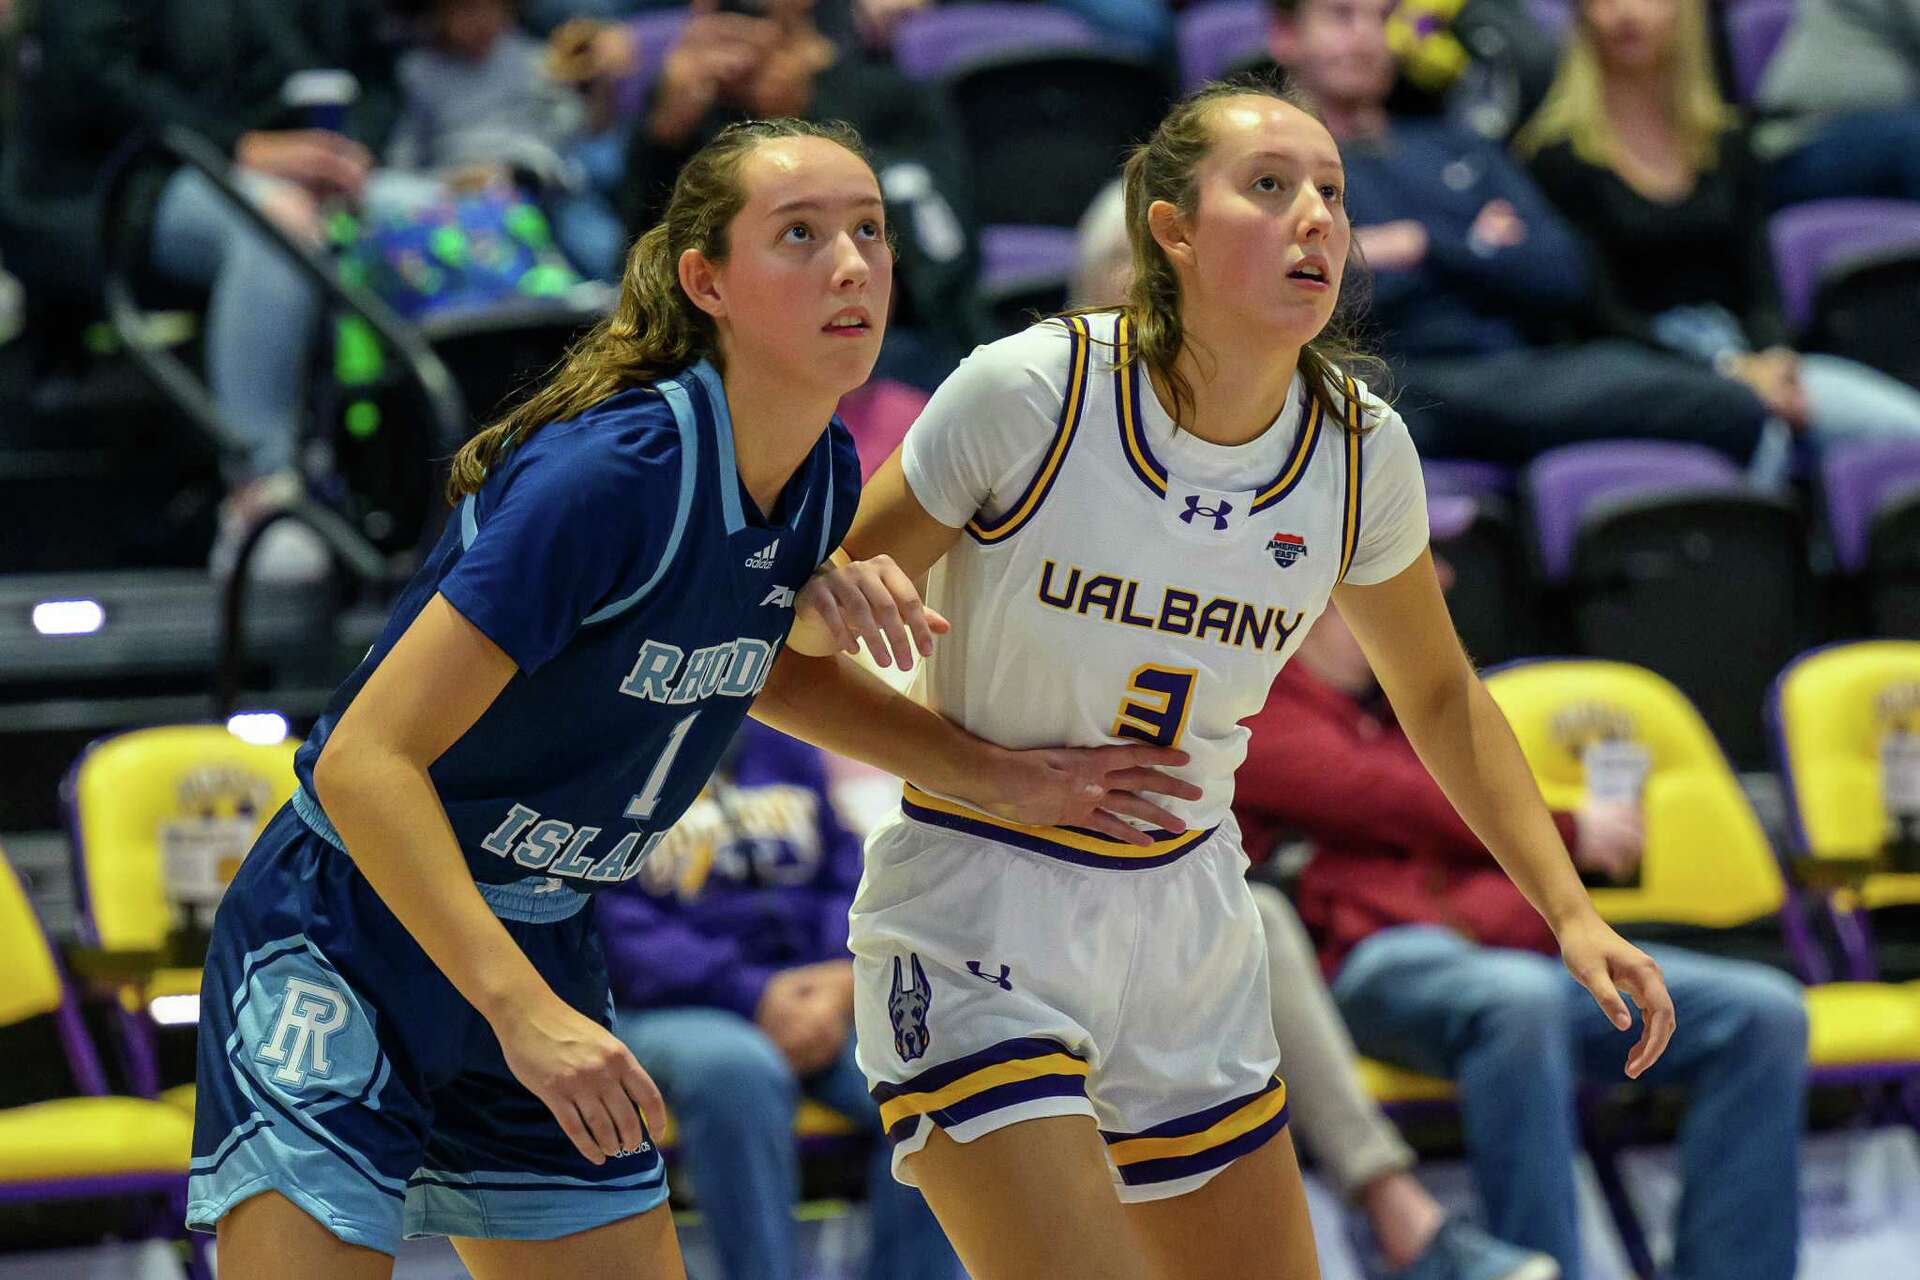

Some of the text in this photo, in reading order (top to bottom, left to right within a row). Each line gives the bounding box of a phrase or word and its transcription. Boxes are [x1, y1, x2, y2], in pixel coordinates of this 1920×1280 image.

[1265, 540, 1307, 557] AMERICA
[1274, 549, 1298, 560] EAST
[1038, 558, 1305, 655] UALBANY
[1111, 661, 1199, 750] 3
[622, 709, 702, 820] 1
[614, 1141, 651, 1158] adas
